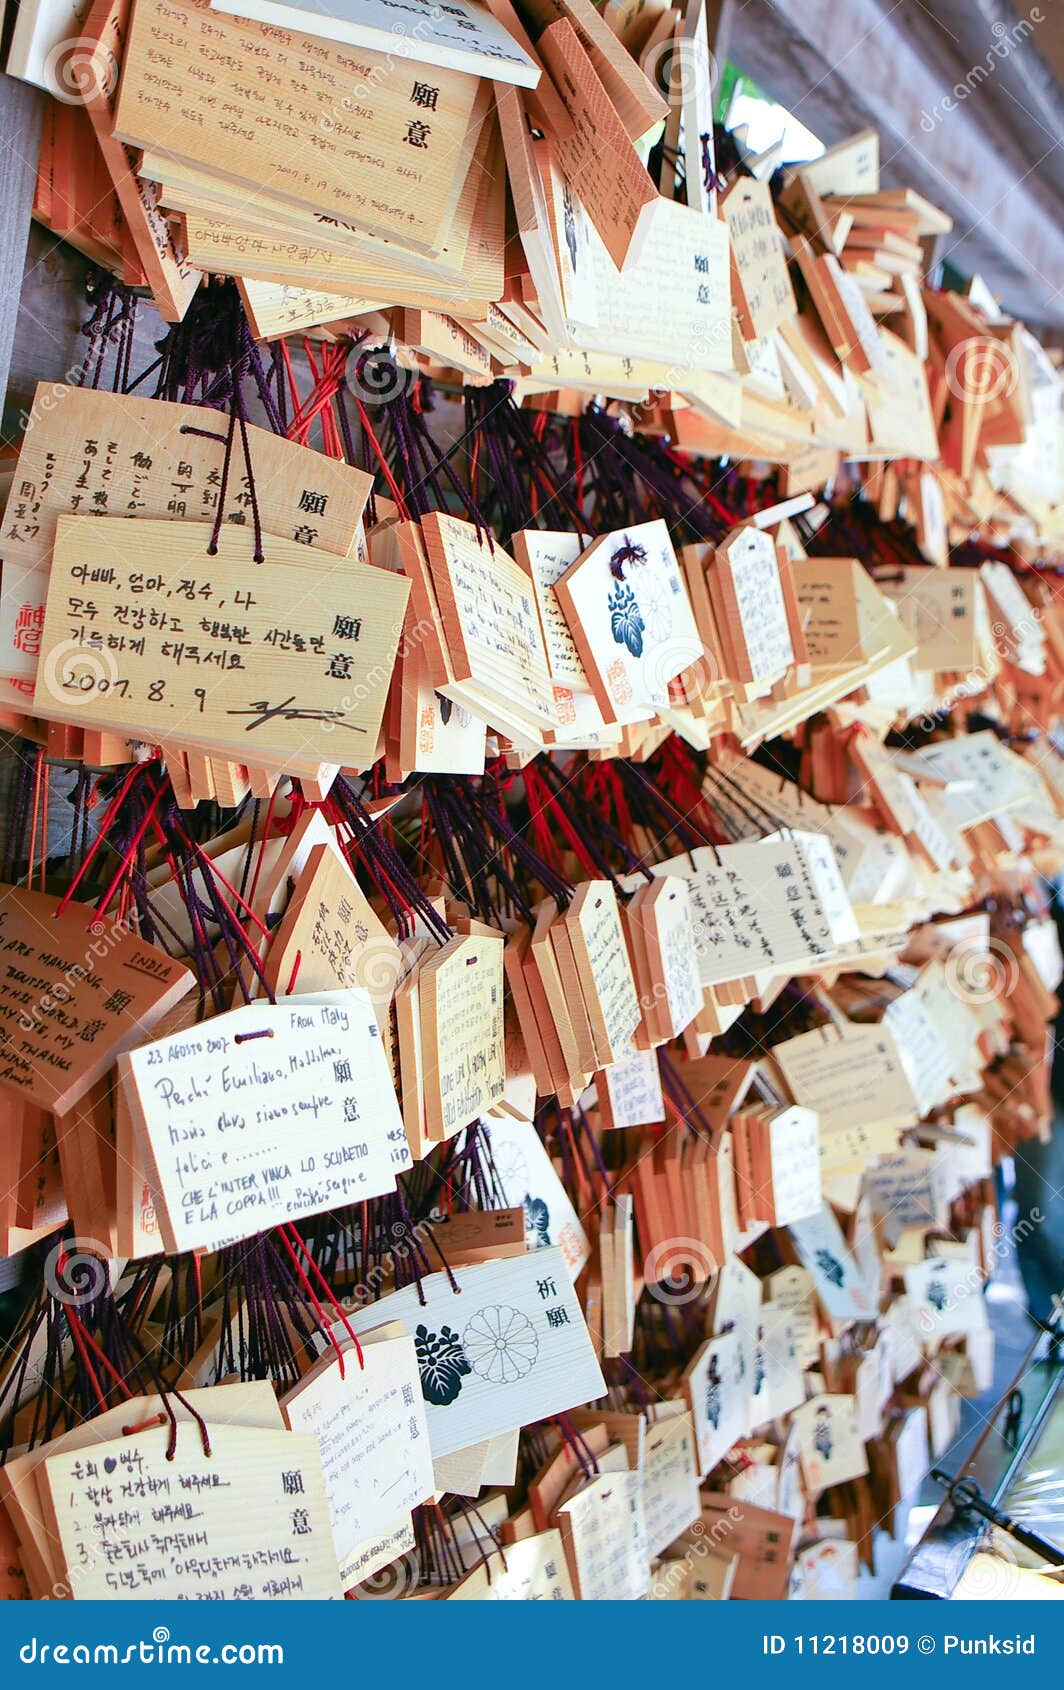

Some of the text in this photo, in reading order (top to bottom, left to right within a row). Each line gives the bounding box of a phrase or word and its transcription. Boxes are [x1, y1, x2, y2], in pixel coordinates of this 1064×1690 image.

[402, 81, 440, 149] 願意
[67, 597, 99, 621] 모두
[113, 605, 185, 633] 건강하고
[198, 617, 252, 645] 행복한
[160, 641, 246, 671] 해주세요
[325, 615, 363, 680] 願意
[194, 687, 207, 713] 9
[129, 951, 173, 978] INDIA
[332, 1058, 360, 1122] 願意
[181, 1190, 204, 1208] CHE
[300, 1156, 316, 1173] LO
[200, 1203, 218, 1222] LA
[535, 1276, 571, 1328] 祈願
[281, 1469, 312, 1535] 願意
